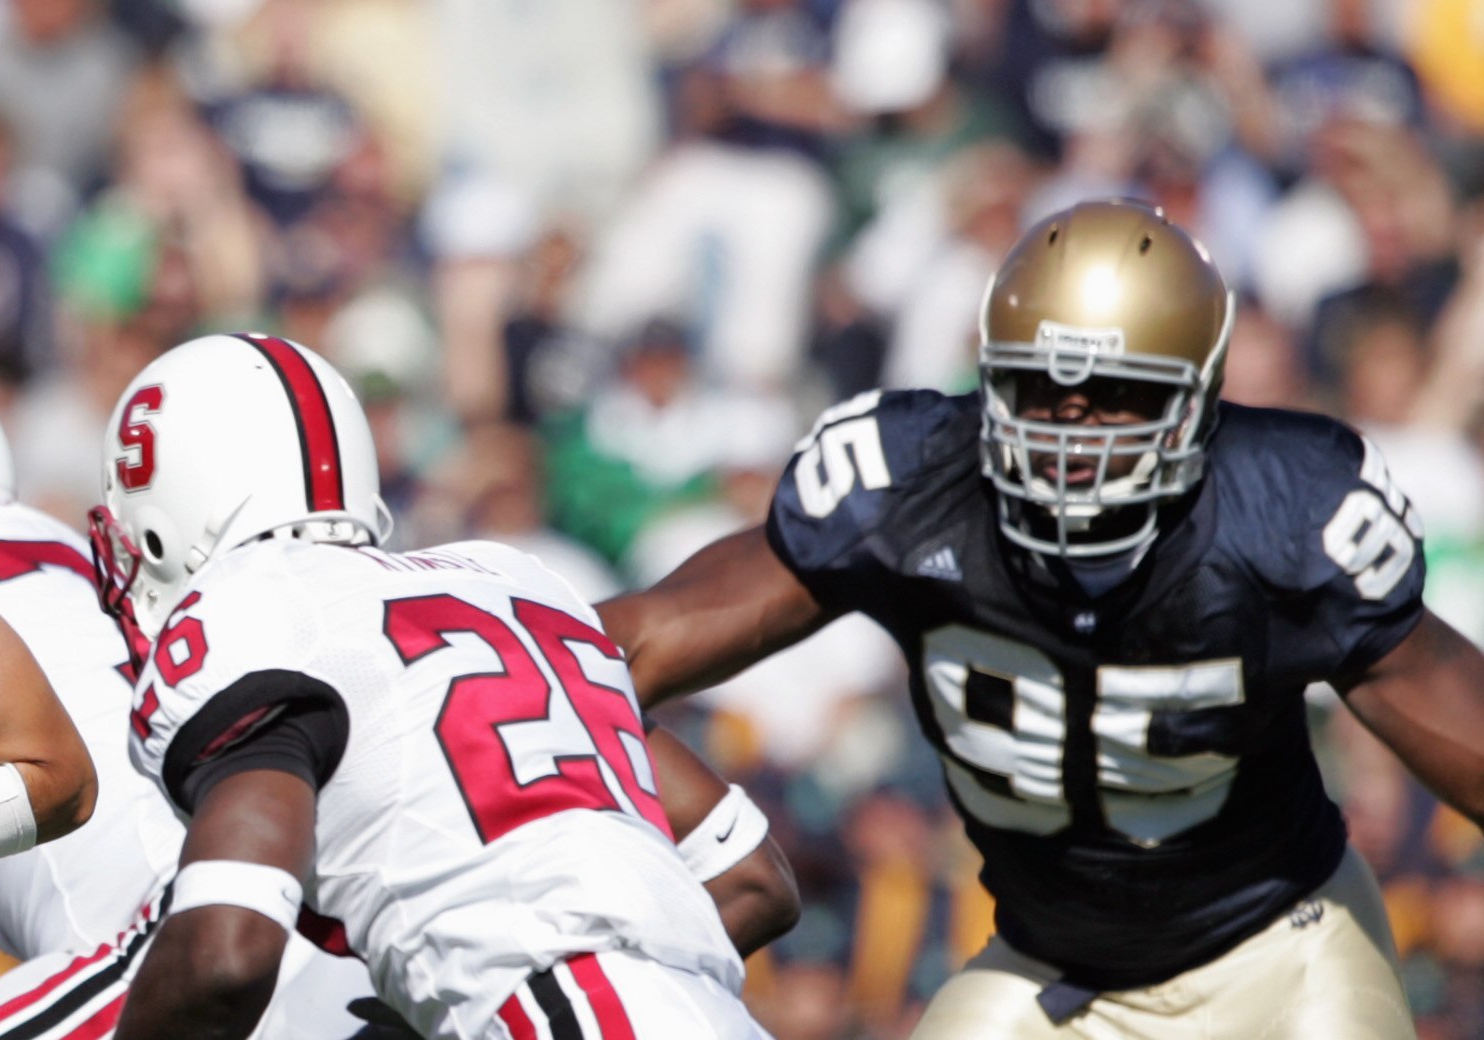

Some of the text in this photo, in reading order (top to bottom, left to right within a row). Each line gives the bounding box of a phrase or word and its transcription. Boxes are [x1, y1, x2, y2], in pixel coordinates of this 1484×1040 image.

[114, 383, 165, 493] S
[382, 592, 676, 846] 26
[922, 622, 1244, 849] 95
